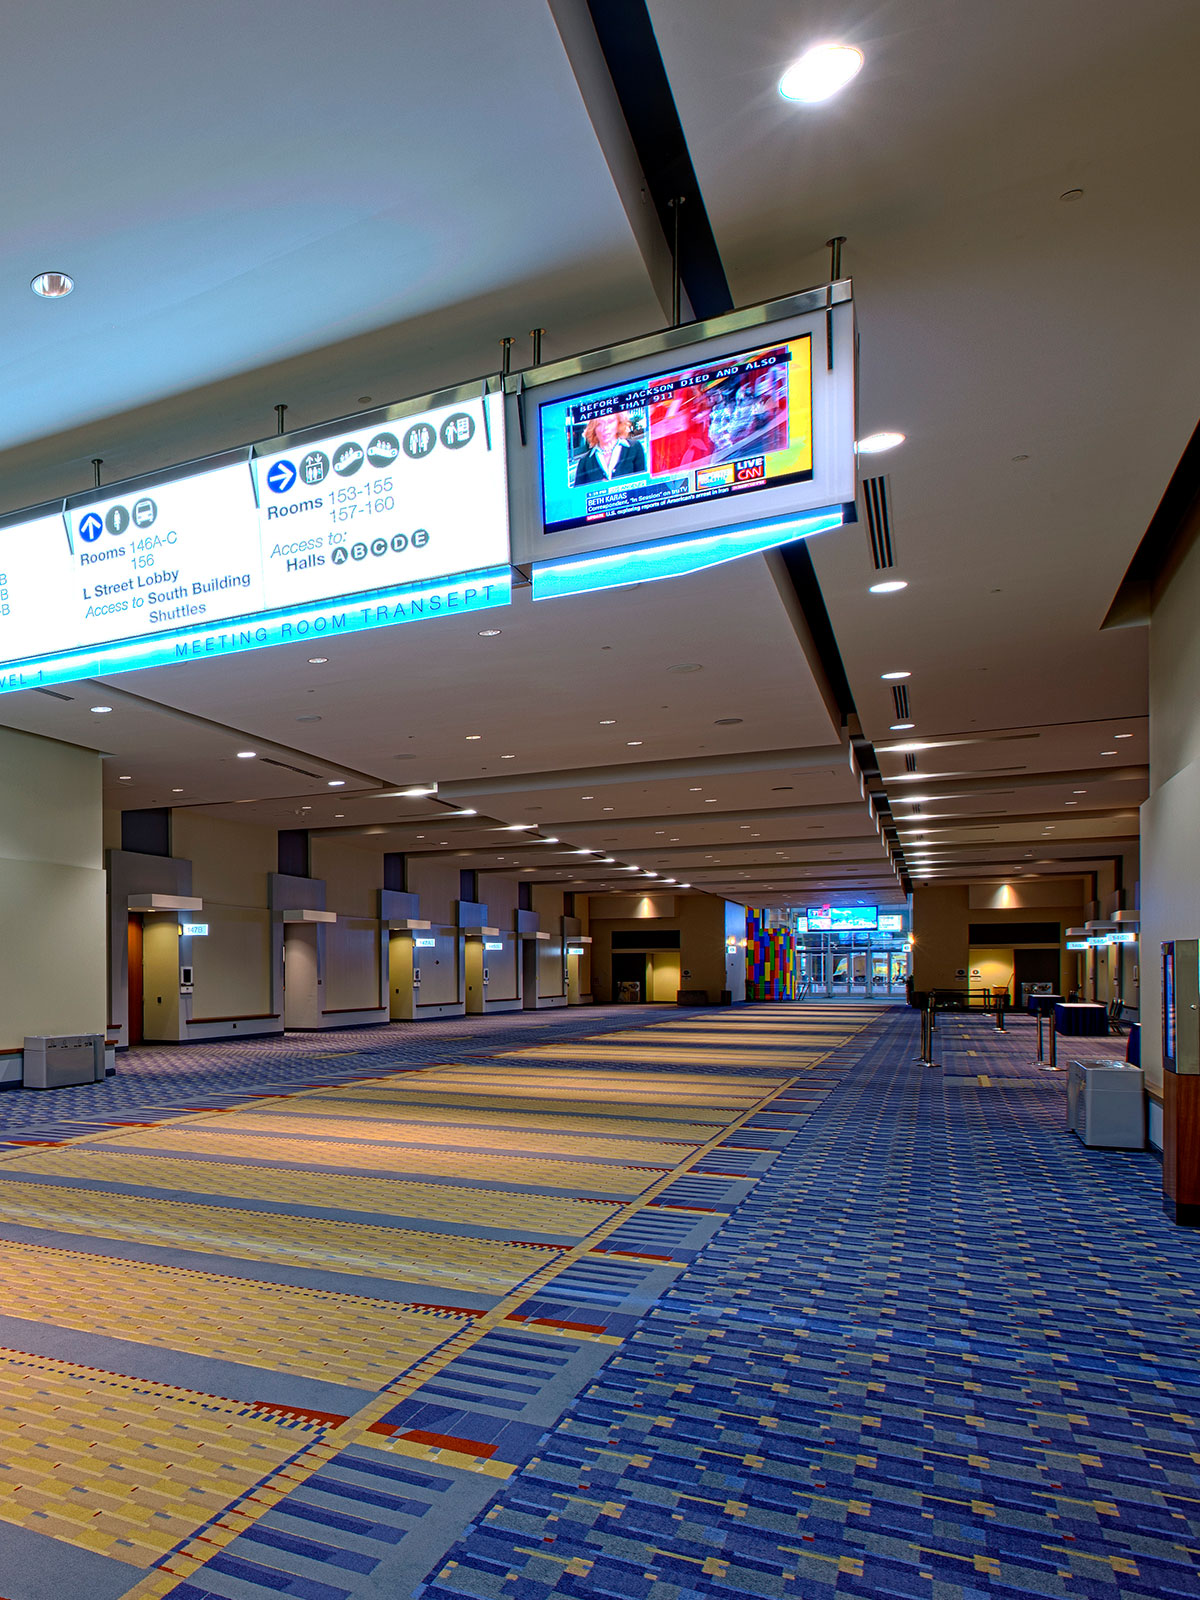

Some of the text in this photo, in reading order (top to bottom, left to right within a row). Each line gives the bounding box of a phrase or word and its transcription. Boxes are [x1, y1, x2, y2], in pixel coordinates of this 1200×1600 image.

[580, 356, 776, 412] BEFORE JACKSON DIED AND ALSO
[580, 391, 674, 421] AFTER THAT 911
[736, 458, 764, 470] LIVE
[737, 466, 764, 481] CNN
[267, 476, 394, 520] Rooms 153-155
[329, 496, 395, 523] 157-160
[588, 497, 605, 507] BETH
[605, 492, 628, 503] KARAS
[80, 530, 178, 567] Rooms 146A-C
[270, 530, 348, 559] Access to:
[286, 531, 427, 573] Halls A B C D E
[131, 553, 155, 570] 156
[83, 569, 180, 601] L Street Lobby
[85, 573, 251, 619] Access to South Building
[149, 603, 207, 624] Shuttles
[175, 584, 495, 657] MEETING ROOM TRANSEPT
[37, 669, 44, 682] 1
